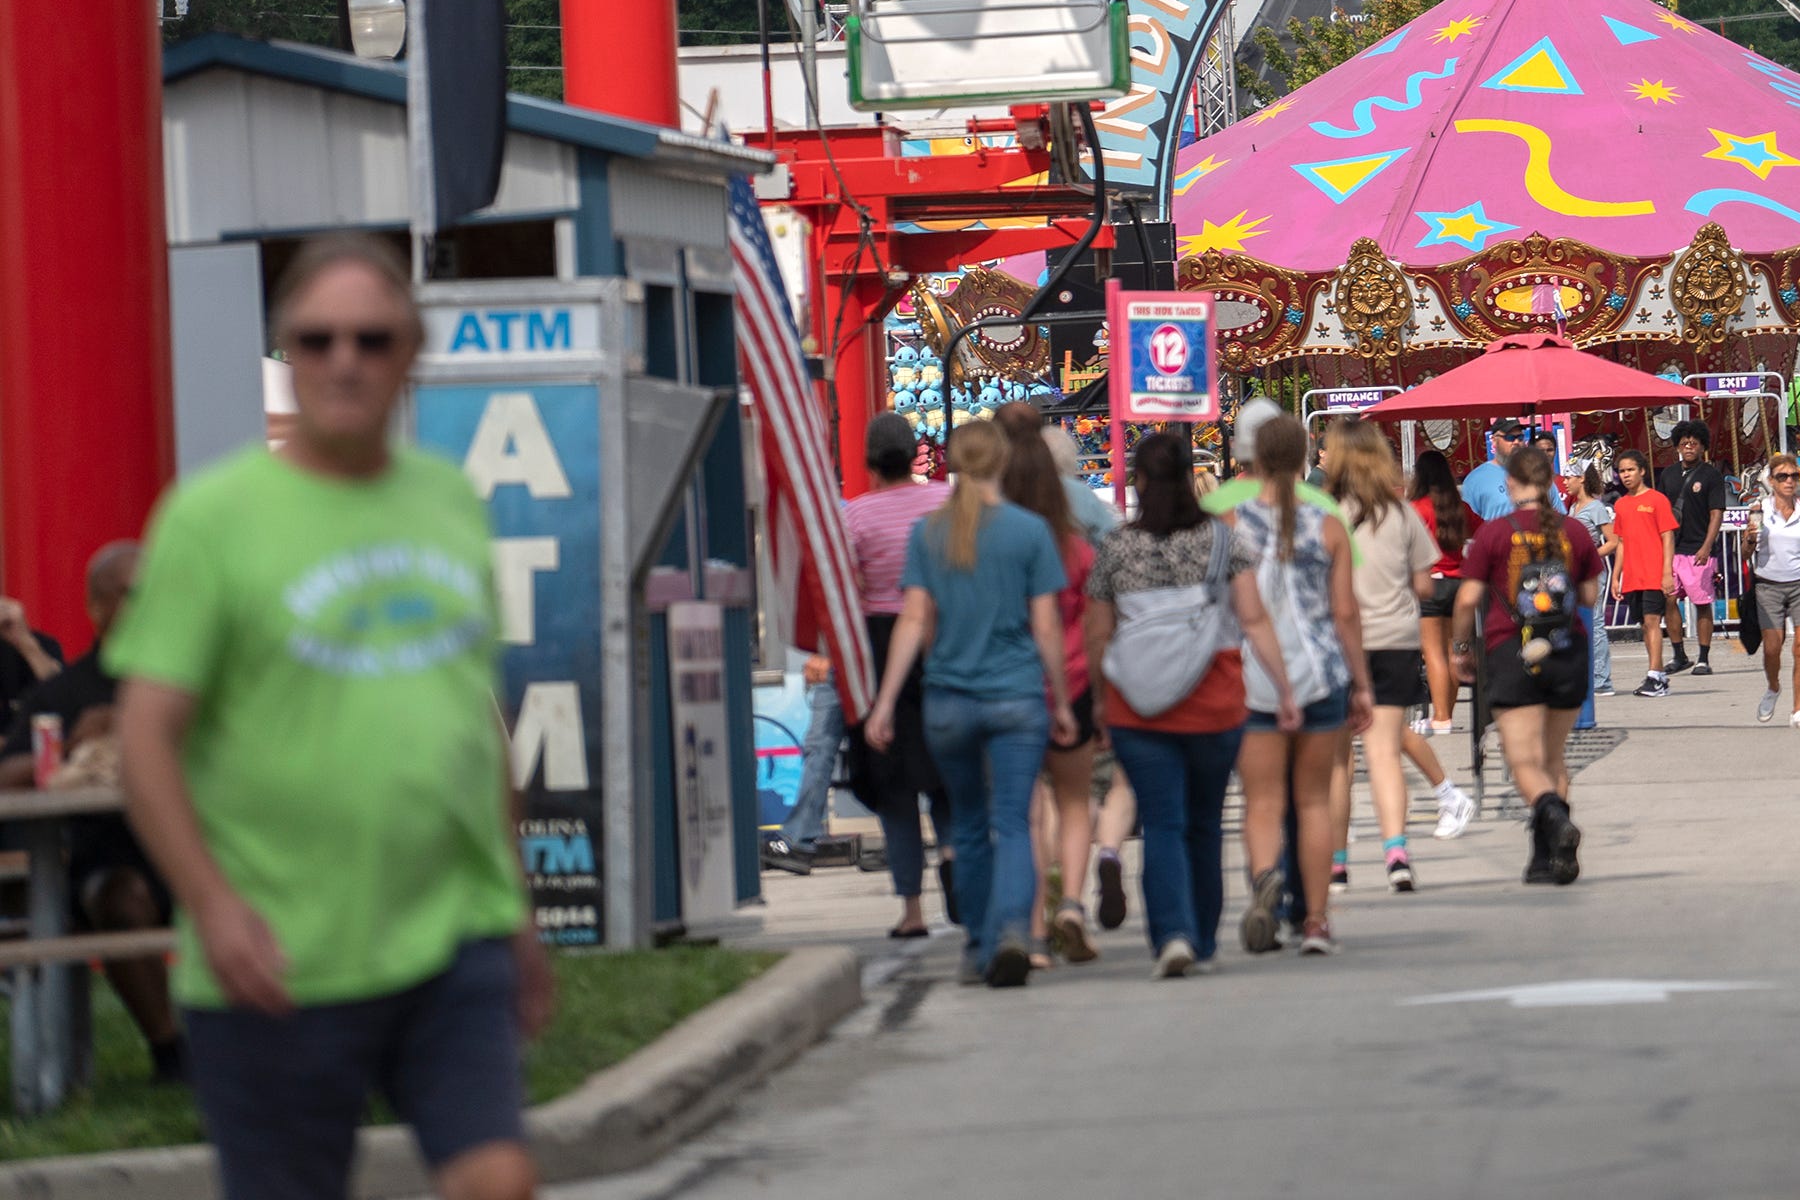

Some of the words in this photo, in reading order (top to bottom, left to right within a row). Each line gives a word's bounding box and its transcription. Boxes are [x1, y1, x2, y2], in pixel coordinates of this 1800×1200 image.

[450, 309, 573, 354] ATM
[1152, 330, 1186, 367] 12
[1144, 375, 1194, 392] TICKETS
[1718, 377, 1748, 388] EXIT
[1329, 391, 1379, 403] ENTRANCE
[464, 392, 590, 792] ATM
